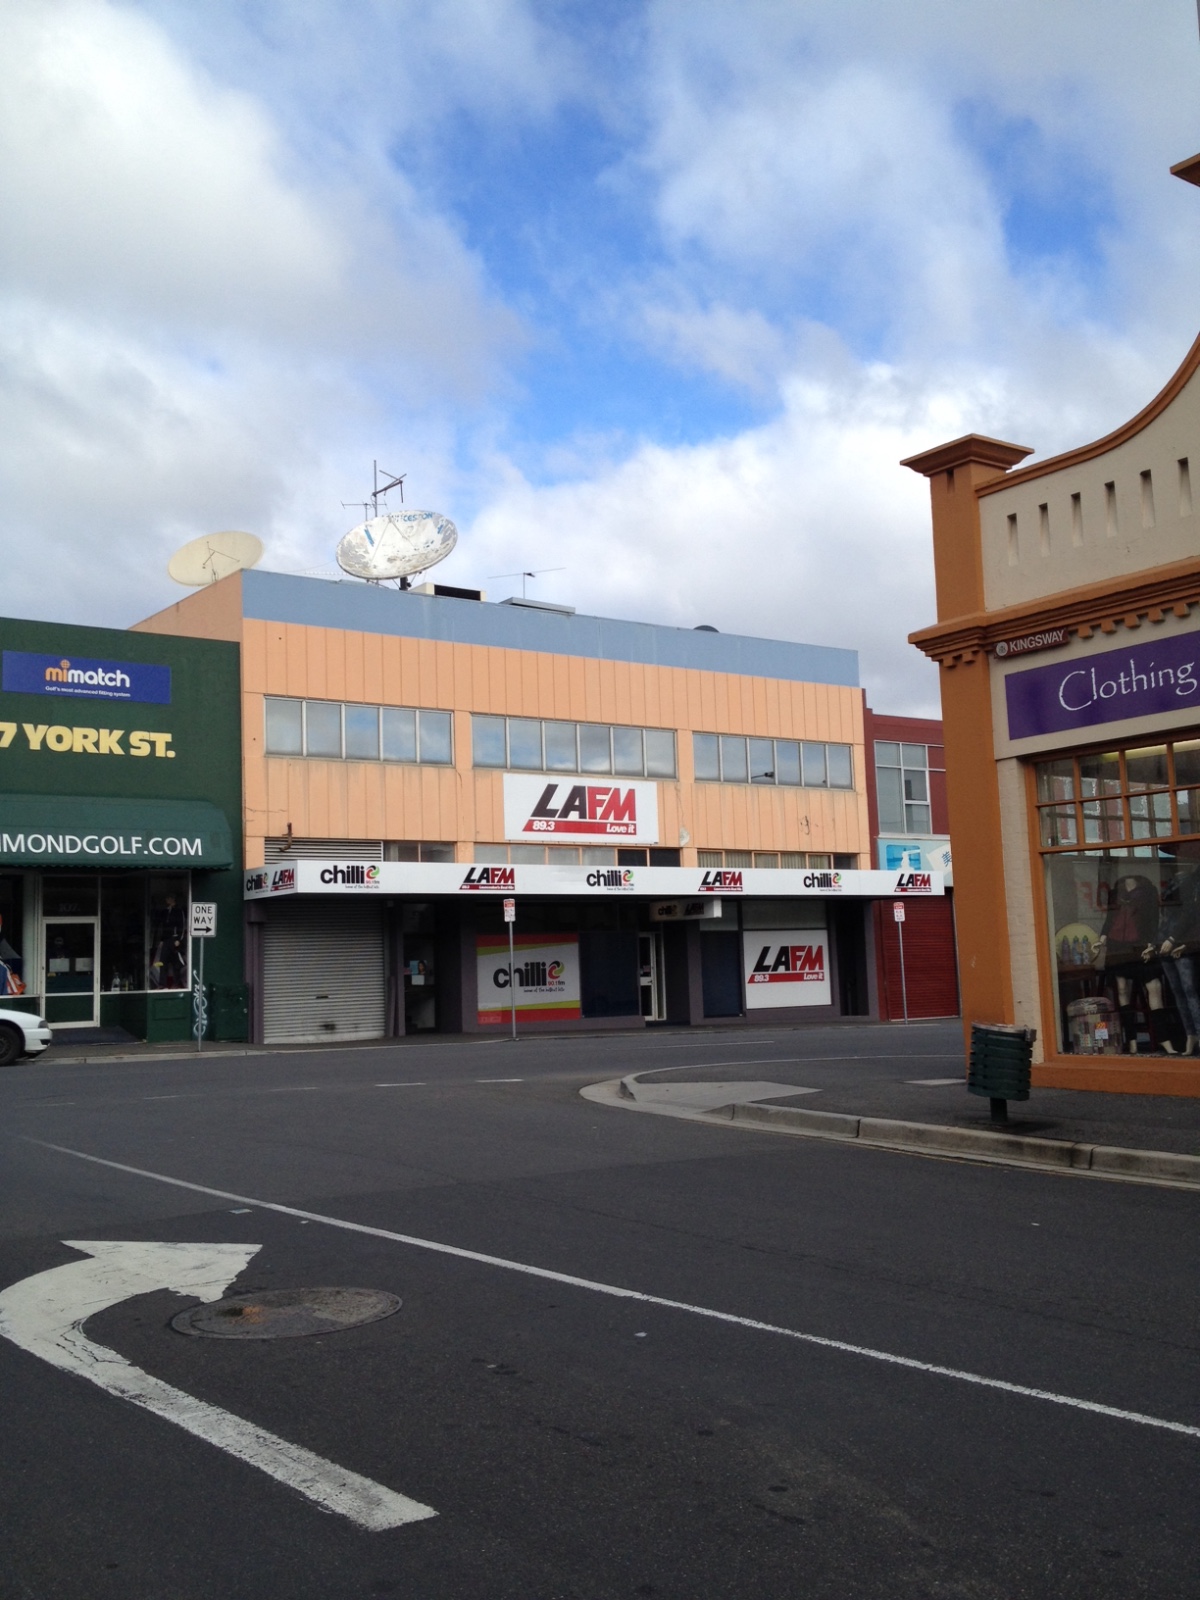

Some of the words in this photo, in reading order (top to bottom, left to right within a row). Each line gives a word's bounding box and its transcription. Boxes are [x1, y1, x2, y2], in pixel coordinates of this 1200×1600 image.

[1009, 629, 1065, 652] KINGSWAY
[45, 659, 130, 688] mimatch
[1058, 658, 1198, 711] Clothing
[0, 721, 17, 748] 7
[22, 723, 125, 755] YORK
[129, 731, 176, 758] ST.
[530, 783, 637, 821] LAFM
[532, 820, 555, 831] 89.3
[606, 823, 627, 833] Love
[627, 824, 635, 833] it
[0, 833, 202, 856] MONDGOLF.COM
[272, 868, 295, 886] LAFM
[320, 865, 364, 884] chilli
[463, 867, 515, 883] LAFM
[586, 869, 622, 887] chilli
[700, 870, 743, 885] LAFM
[803, 872, 832, 888] chilli
[896, 873, 931, 886] LAFM
[195, 905, 213, 914] ONE
[193, 916, 213, 924] WAY
[753, 945, 824, 973] LAFM
[493, 961, 547, 988] chilli
[754, 974, 769, 982] 89.3
[818, 972, 824, 980] it
